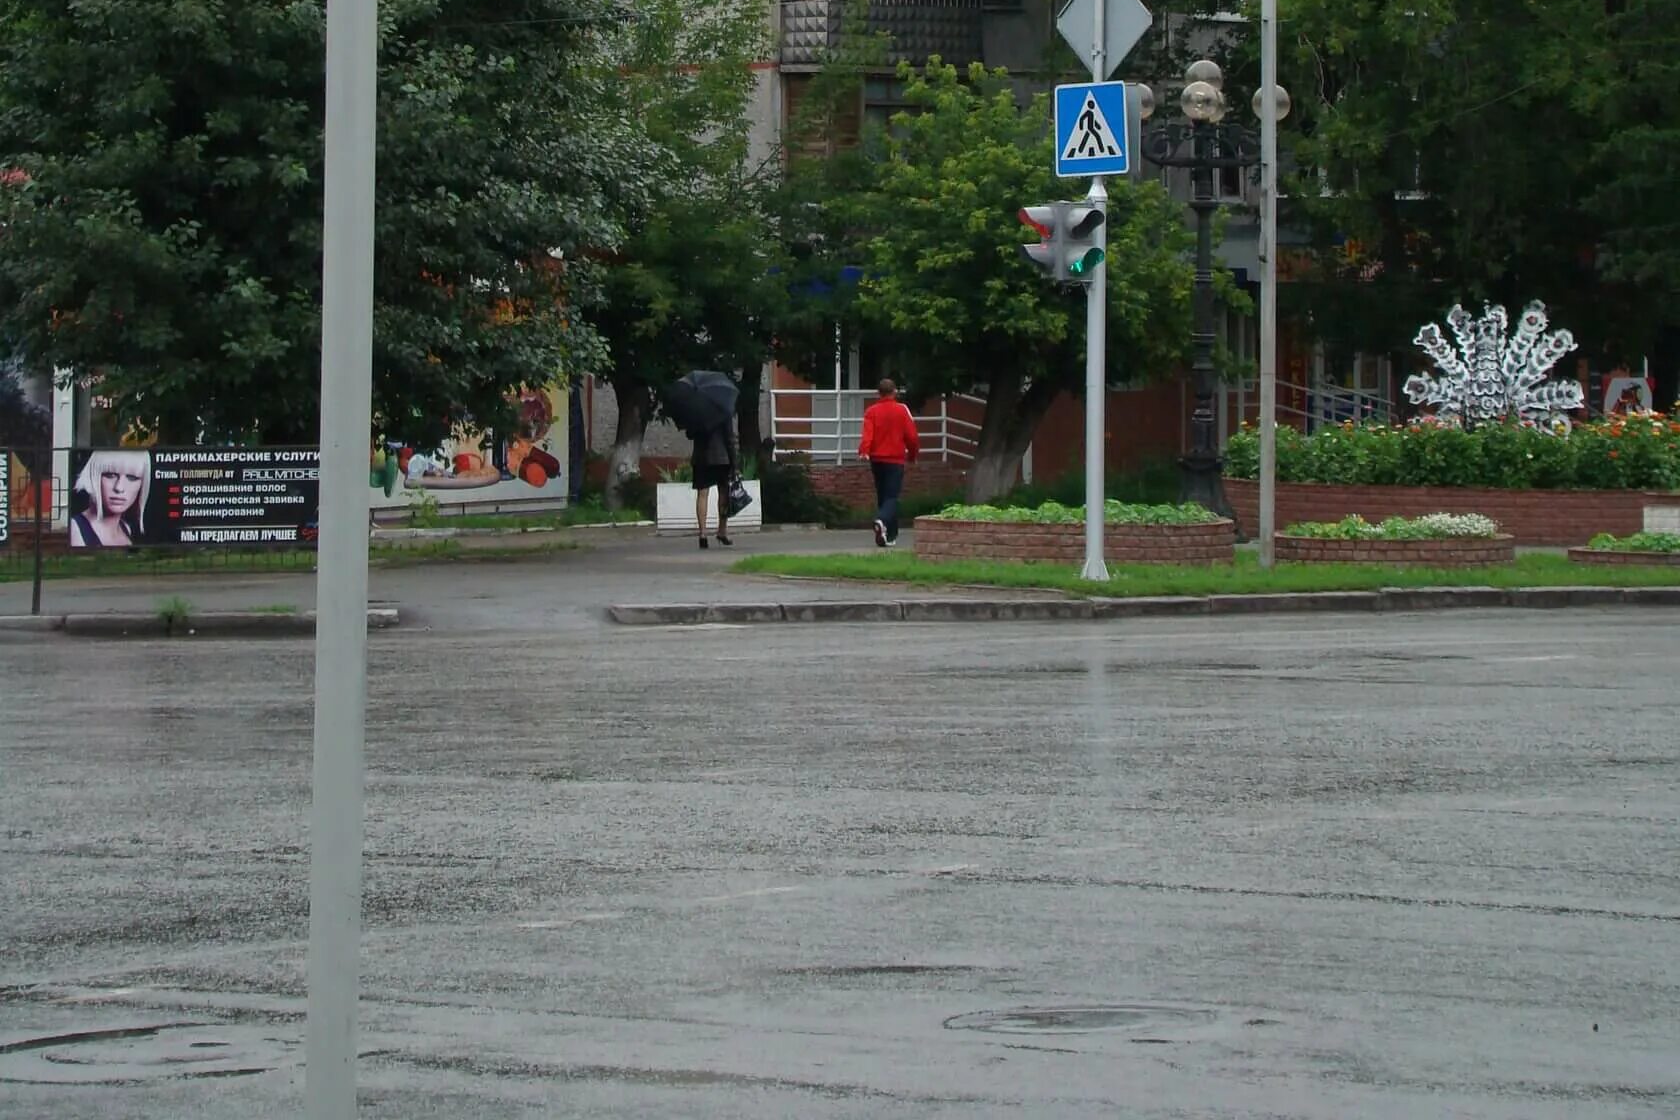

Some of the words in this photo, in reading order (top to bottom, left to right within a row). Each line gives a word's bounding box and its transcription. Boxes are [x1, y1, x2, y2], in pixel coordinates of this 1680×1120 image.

[155, 452, 272, 463] ПАРИКМАХЕРСКИЕ
[274, 451, 320, 461] УСЛУГИ
[243, 470, 273, 479] PAUL
[274, 469, 320, 479] MITCHE
[182, 484, 254, 494] окрашивание
[255, 483, 287, 492] волос
[182, 495, 261, 505] биологическая
[262, 495, 305, 504] завивка
[182, 508, 265, 520] ламинирование
[180, 530, 199, 542] МЫ
[200, 530, 260, 543] ПРЕДЛАГАЕМ
[260, 529, 298, 541] ЛУЧШЕЕ
